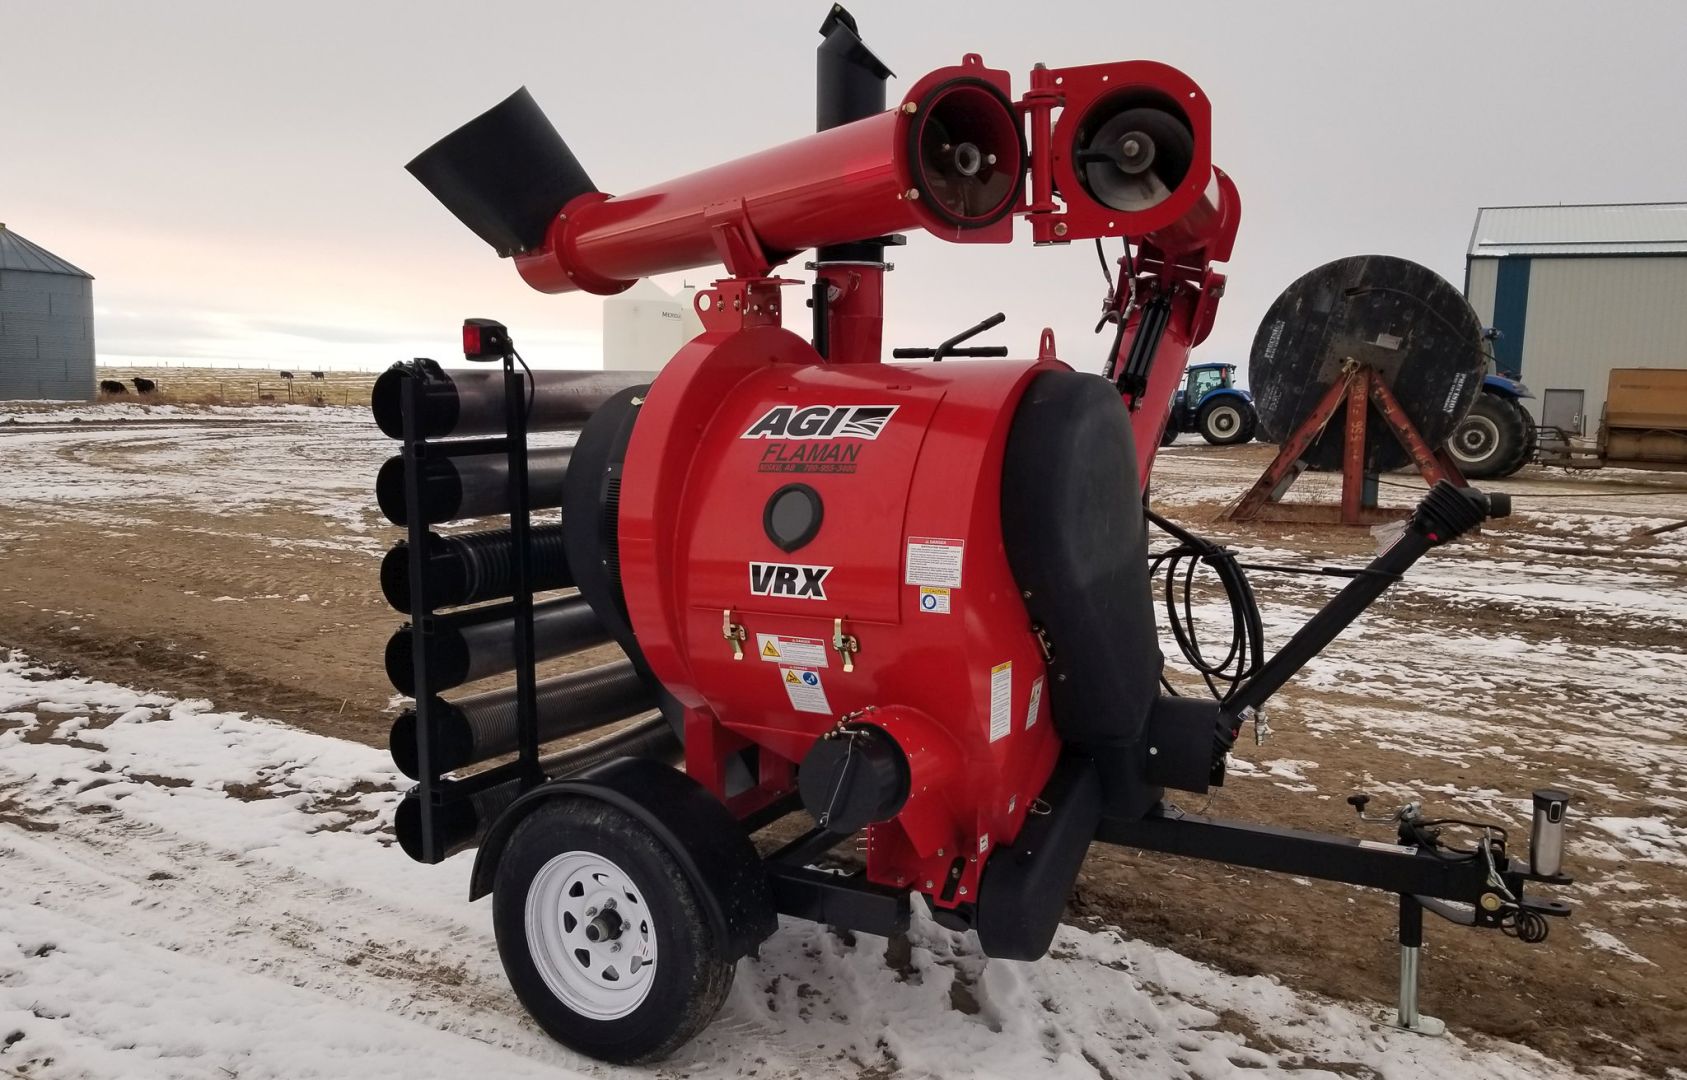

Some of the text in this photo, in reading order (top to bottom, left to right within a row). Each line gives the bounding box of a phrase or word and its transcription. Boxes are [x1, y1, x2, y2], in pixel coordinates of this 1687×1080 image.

[747, 407, 851, 436] AGI
[761, 443, 863, 462] FLAMAN
[751, 564, 829, 597] VRX
